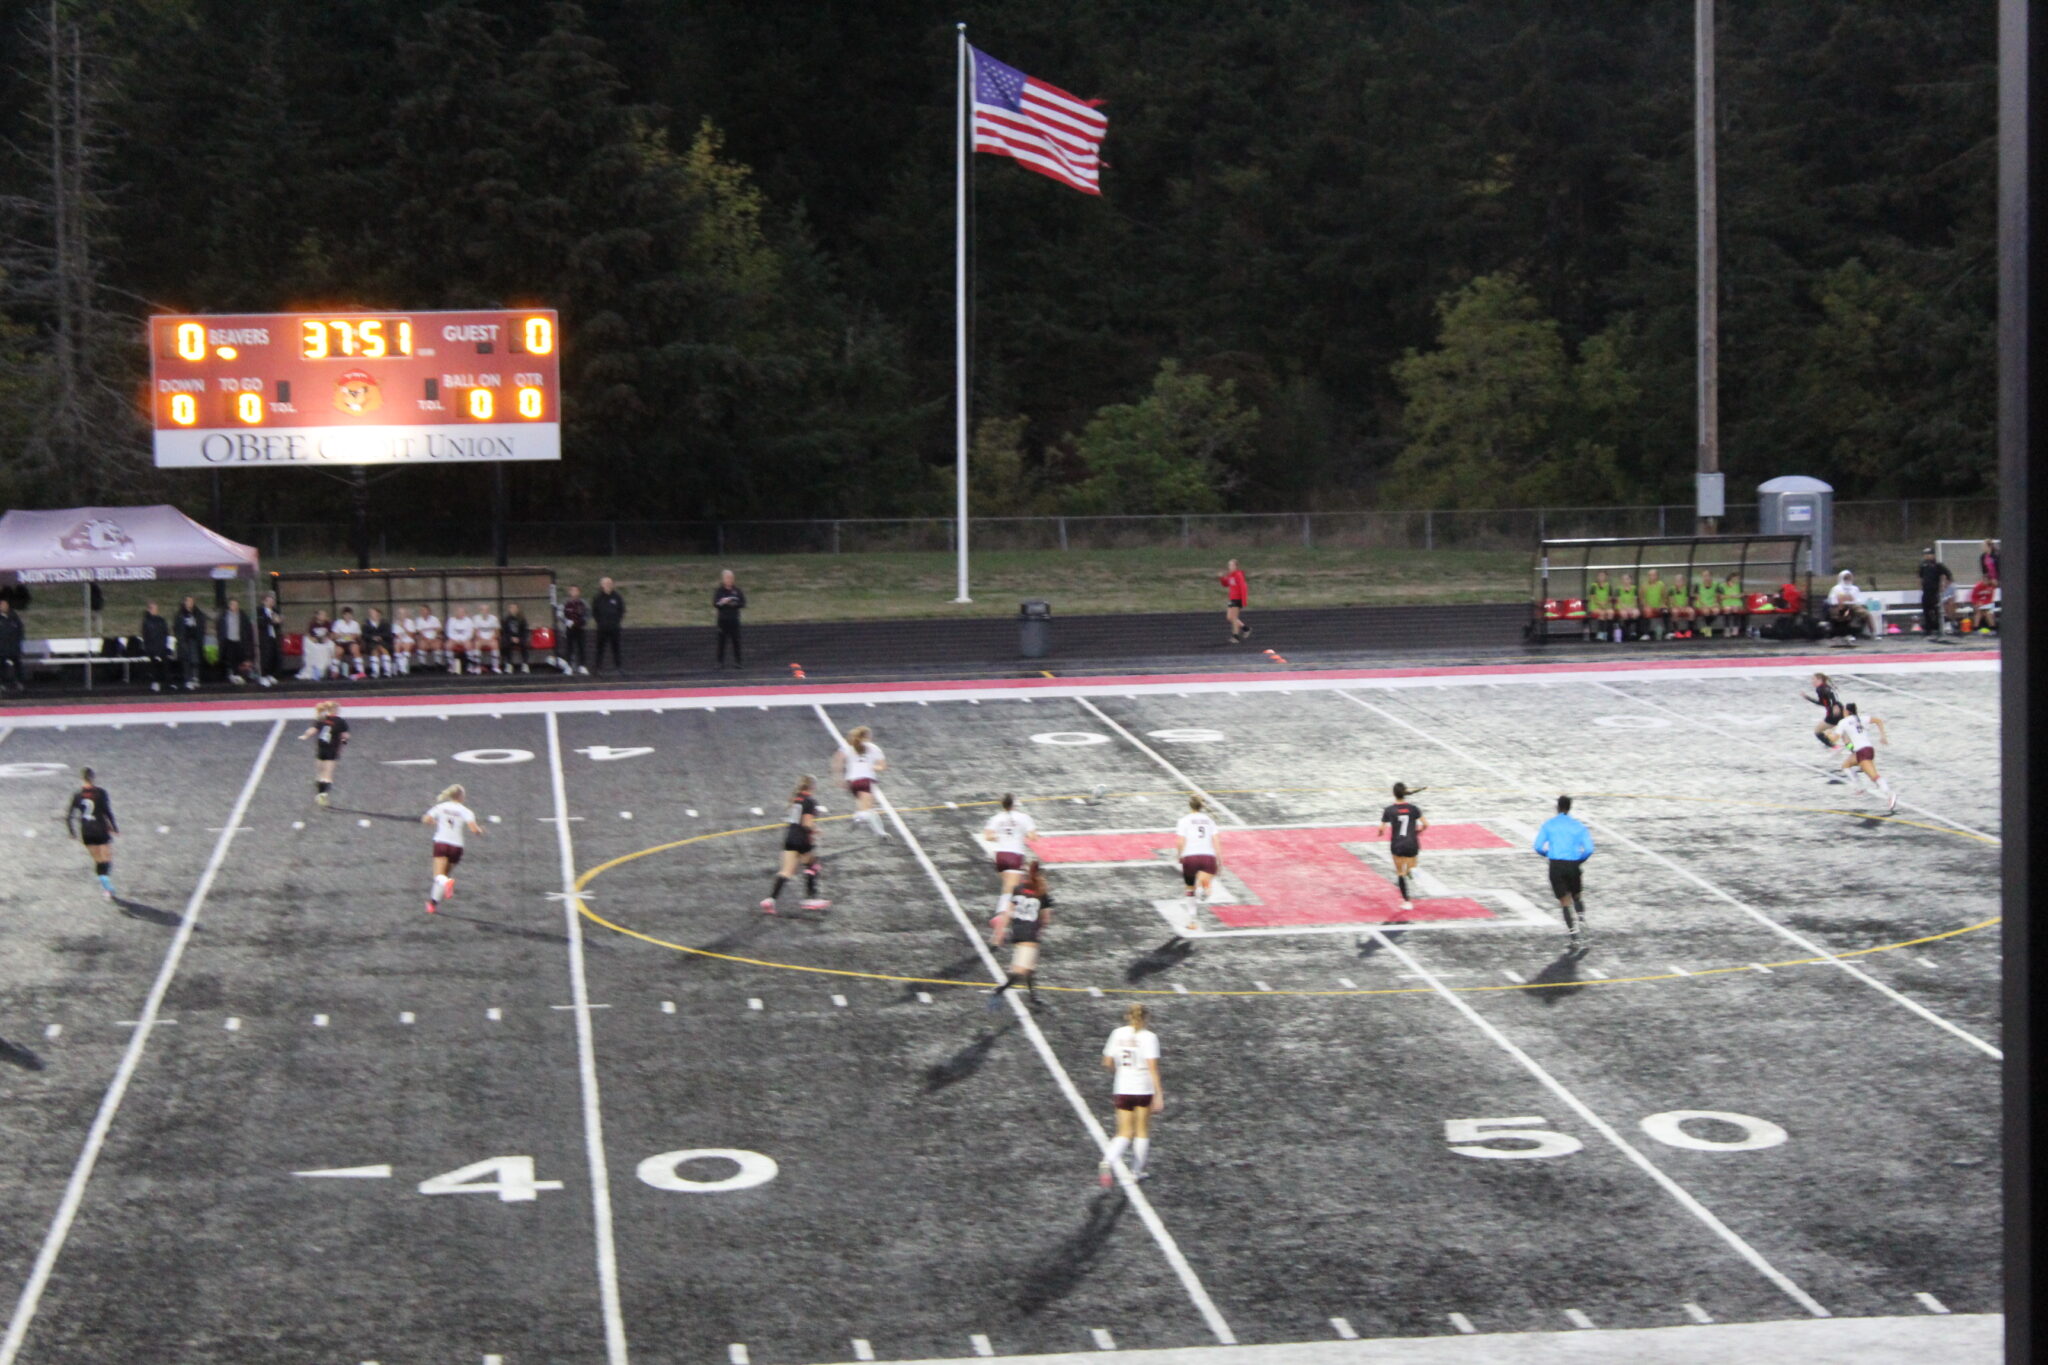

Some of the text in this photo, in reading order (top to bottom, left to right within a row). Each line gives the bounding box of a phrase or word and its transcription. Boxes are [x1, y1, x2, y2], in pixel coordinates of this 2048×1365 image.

[178, 323, 206, 360] 0
[209, 328, 270, 346] BEAVERS
[443, 325, 499, 342] GUEST
[525, 318, 552, 354] 0
[159, 378, 205, 392] DOWN
[218, 377, 264, 391] TO GO
[443, 373, 502, 388] BALL ON
[513, 372, 543, 387] QTR
[171, 394, 195, 425] 0
[238, 392, 263, 424] 0
[469, 389, 493, 420] 0
[518, 387, 542, 419] 0
[425, 434, 515, 459] UNION
[81, 799, 96, 821] 2
[1397, 814, 1409, 836] 7
